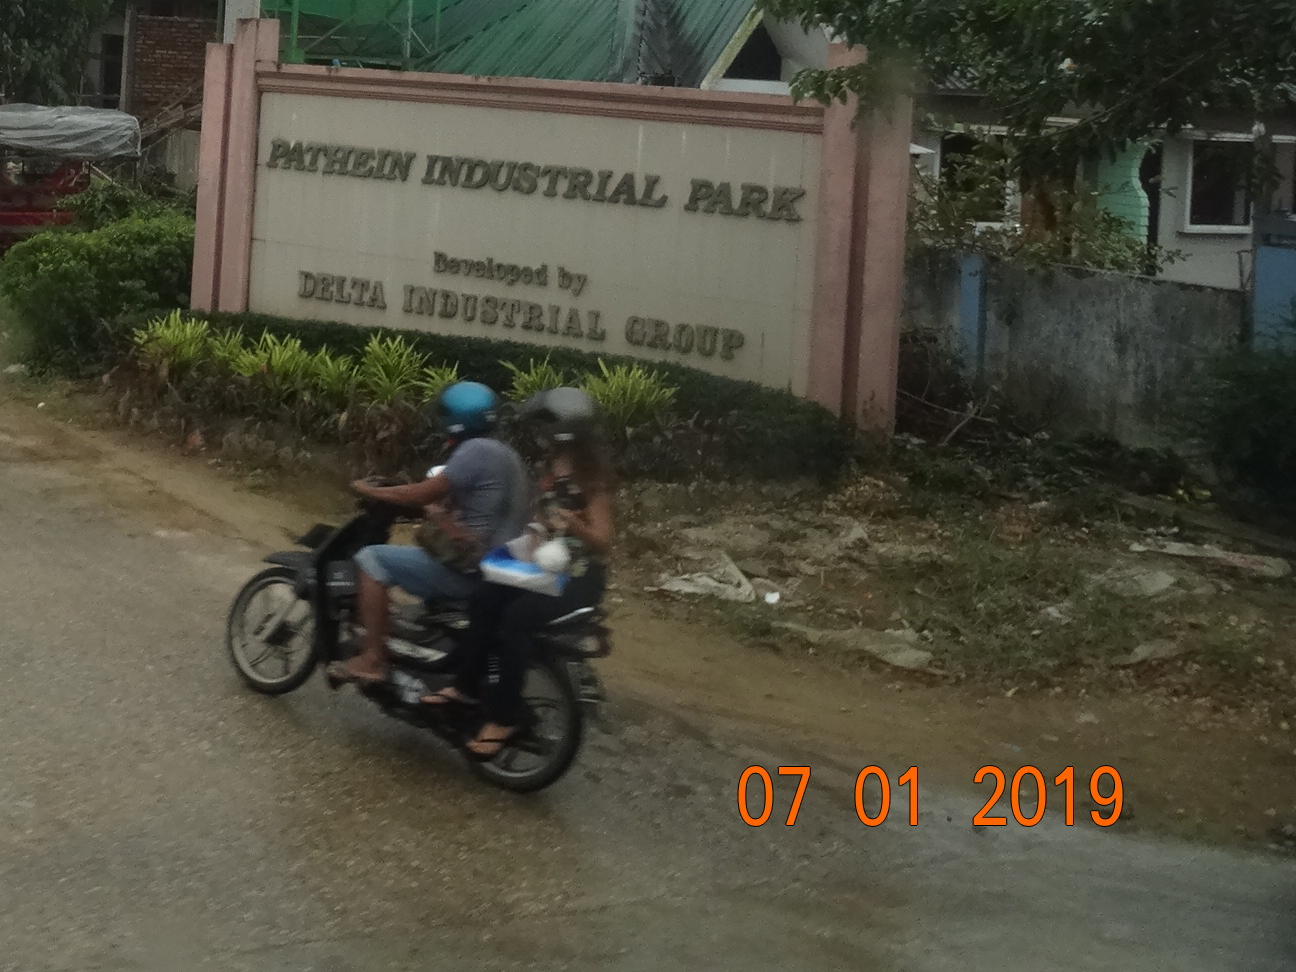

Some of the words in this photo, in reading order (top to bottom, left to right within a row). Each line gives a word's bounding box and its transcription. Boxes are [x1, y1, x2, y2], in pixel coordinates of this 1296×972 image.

[266, 138, 416, 181] PATHEIN
[421, 154, 668, 208] INDUSTRIAL
[683, 178, 805, 223] PARK
[298, 270, 387, 310] DELTA
[402, 284, 606, 341] INDUSTRIAL
[625, 315, 745, 360] GROUP
[433, 251, 548, 286] Developed
[557, 266, 588, 297] by
